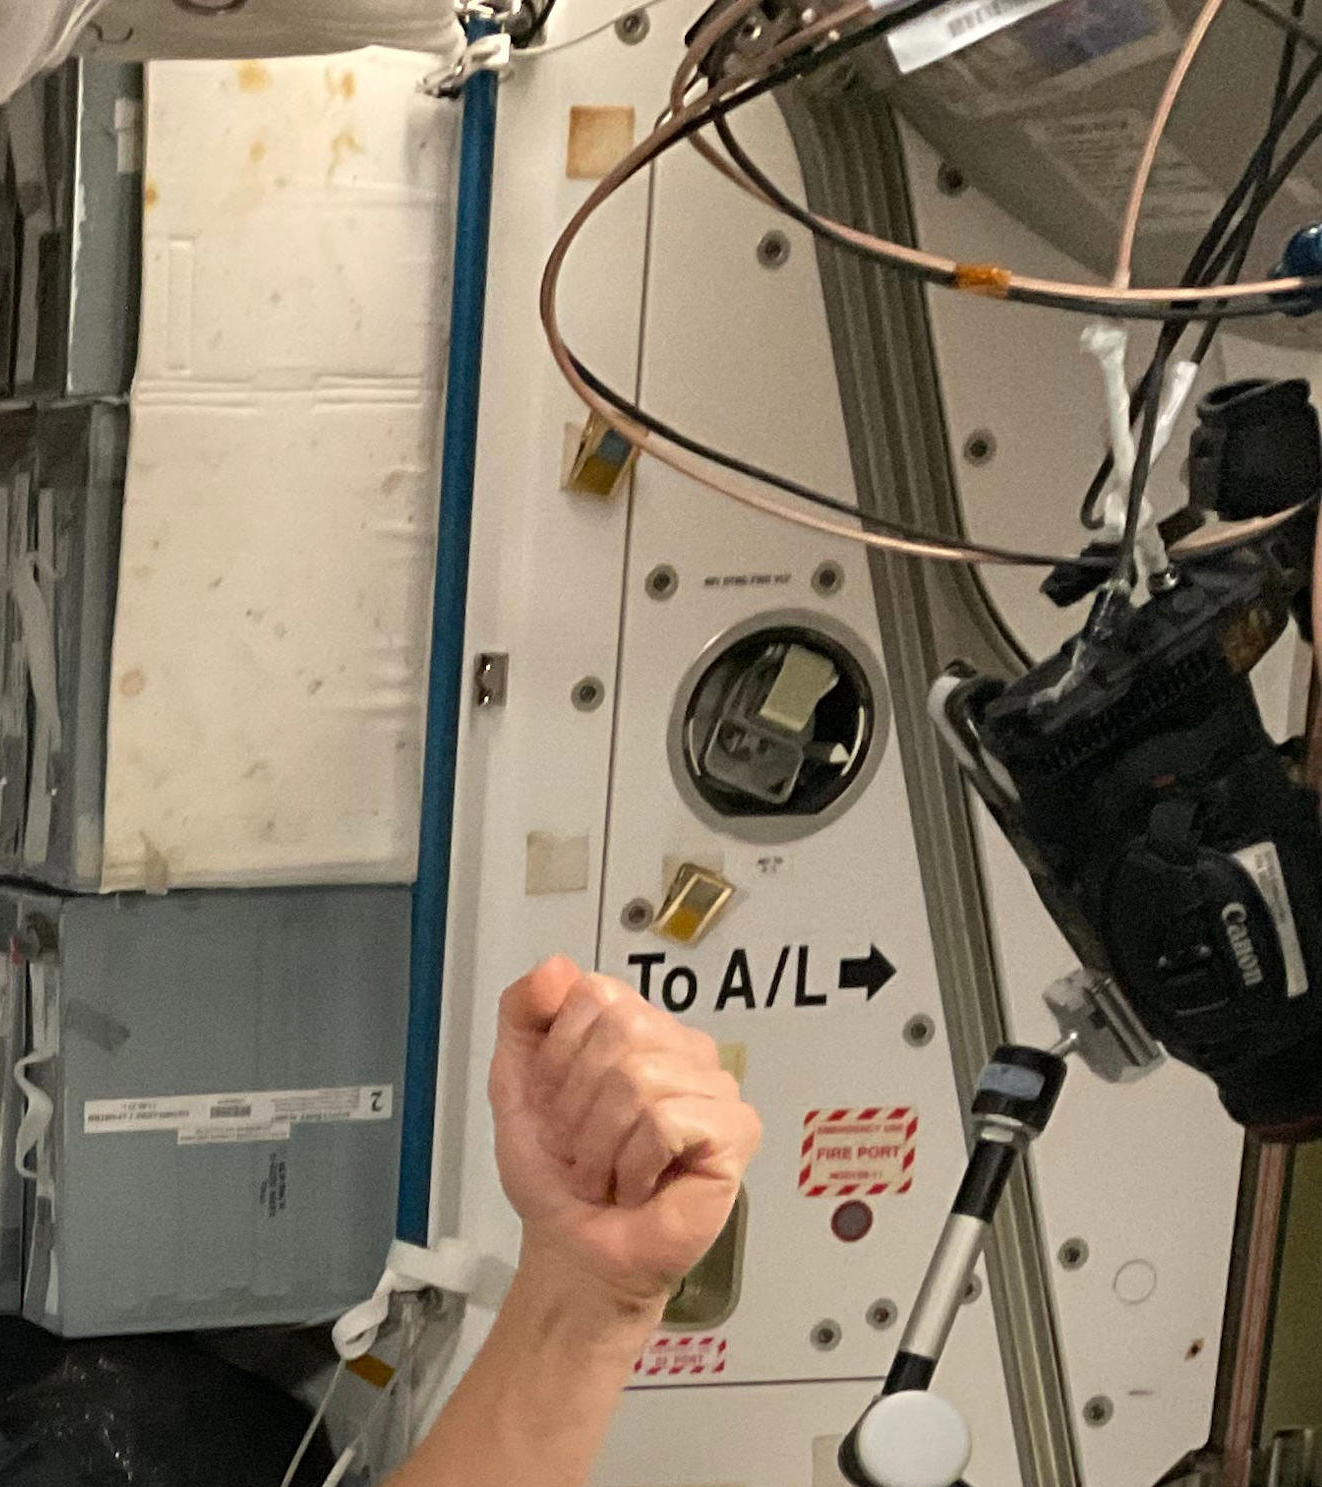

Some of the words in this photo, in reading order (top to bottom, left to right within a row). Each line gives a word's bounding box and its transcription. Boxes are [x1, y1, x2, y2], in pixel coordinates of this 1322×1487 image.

[627, 952, 698, 1013] To
[714, 944, 828, 1011] A/L
[1221, 902, 1264, 987] Canon
[816, 1147, 852, 1160] FIRE
[858, 1145, 899, 1158] PORT
